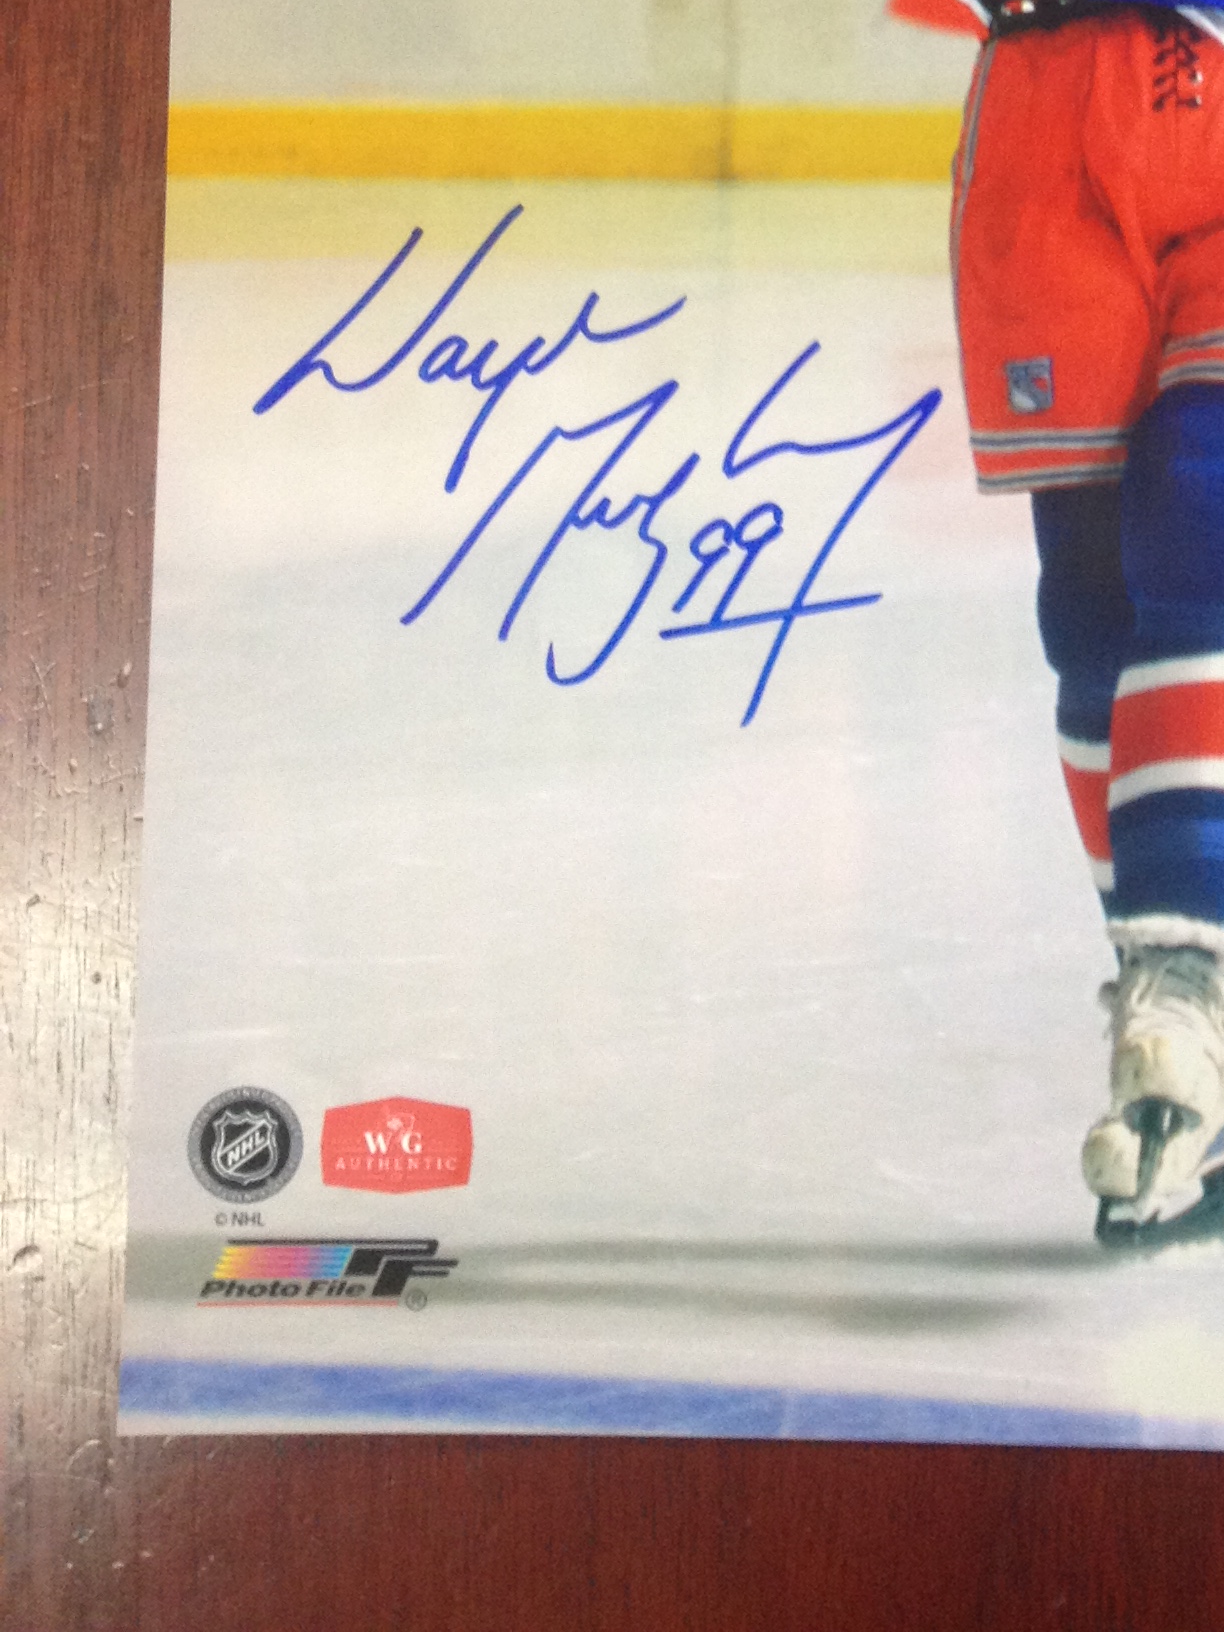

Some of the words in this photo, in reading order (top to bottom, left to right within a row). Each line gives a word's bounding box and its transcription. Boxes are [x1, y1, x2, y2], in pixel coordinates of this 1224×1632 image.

[226, 1129, 265, 1167] NHL
[335, 1157, 457, 1171] AUTHENTIC
[231, 1212, 265, 1226] NHL
[201, 1280, 302, 1298] Photo
[305, 1280, 366, 1297] File
